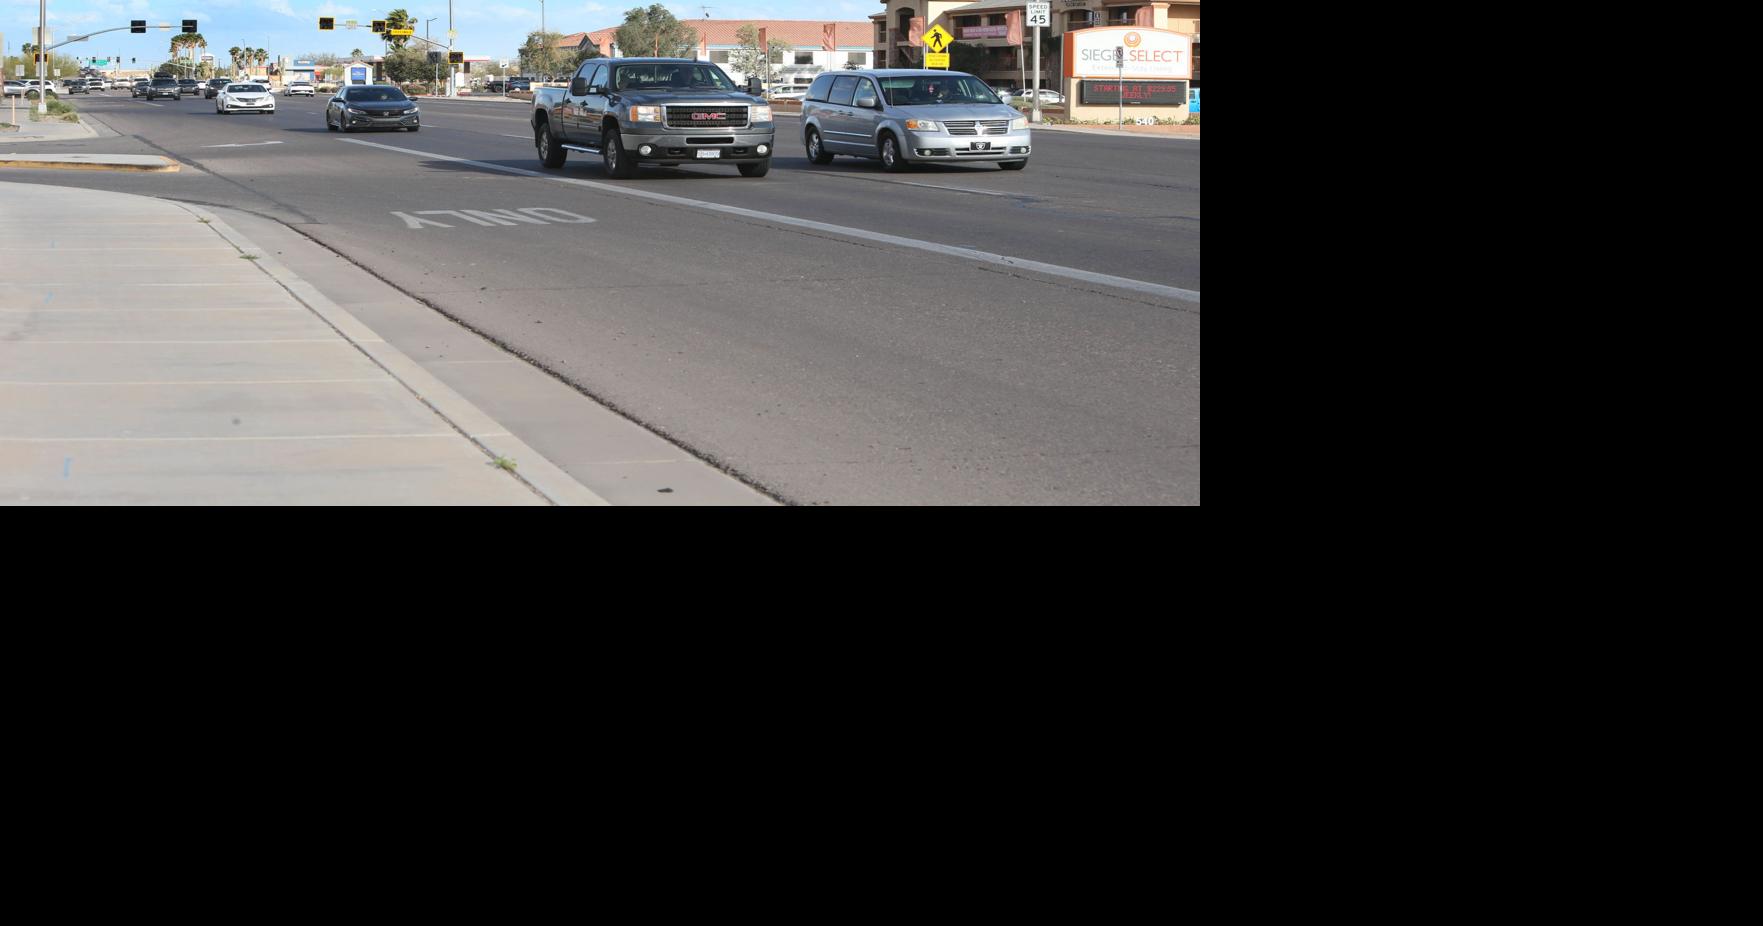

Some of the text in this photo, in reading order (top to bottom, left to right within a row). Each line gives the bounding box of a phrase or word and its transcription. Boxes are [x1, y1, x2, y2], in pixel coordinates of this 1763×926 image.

[1030, 15, 1046, 24] 45
[1129, 49, 1183, 62] SELECT
[691, 112, 727, 120] GMC
[1136, 117, 1153, 125] 540
[390, 207, 597, 228] ONLY
